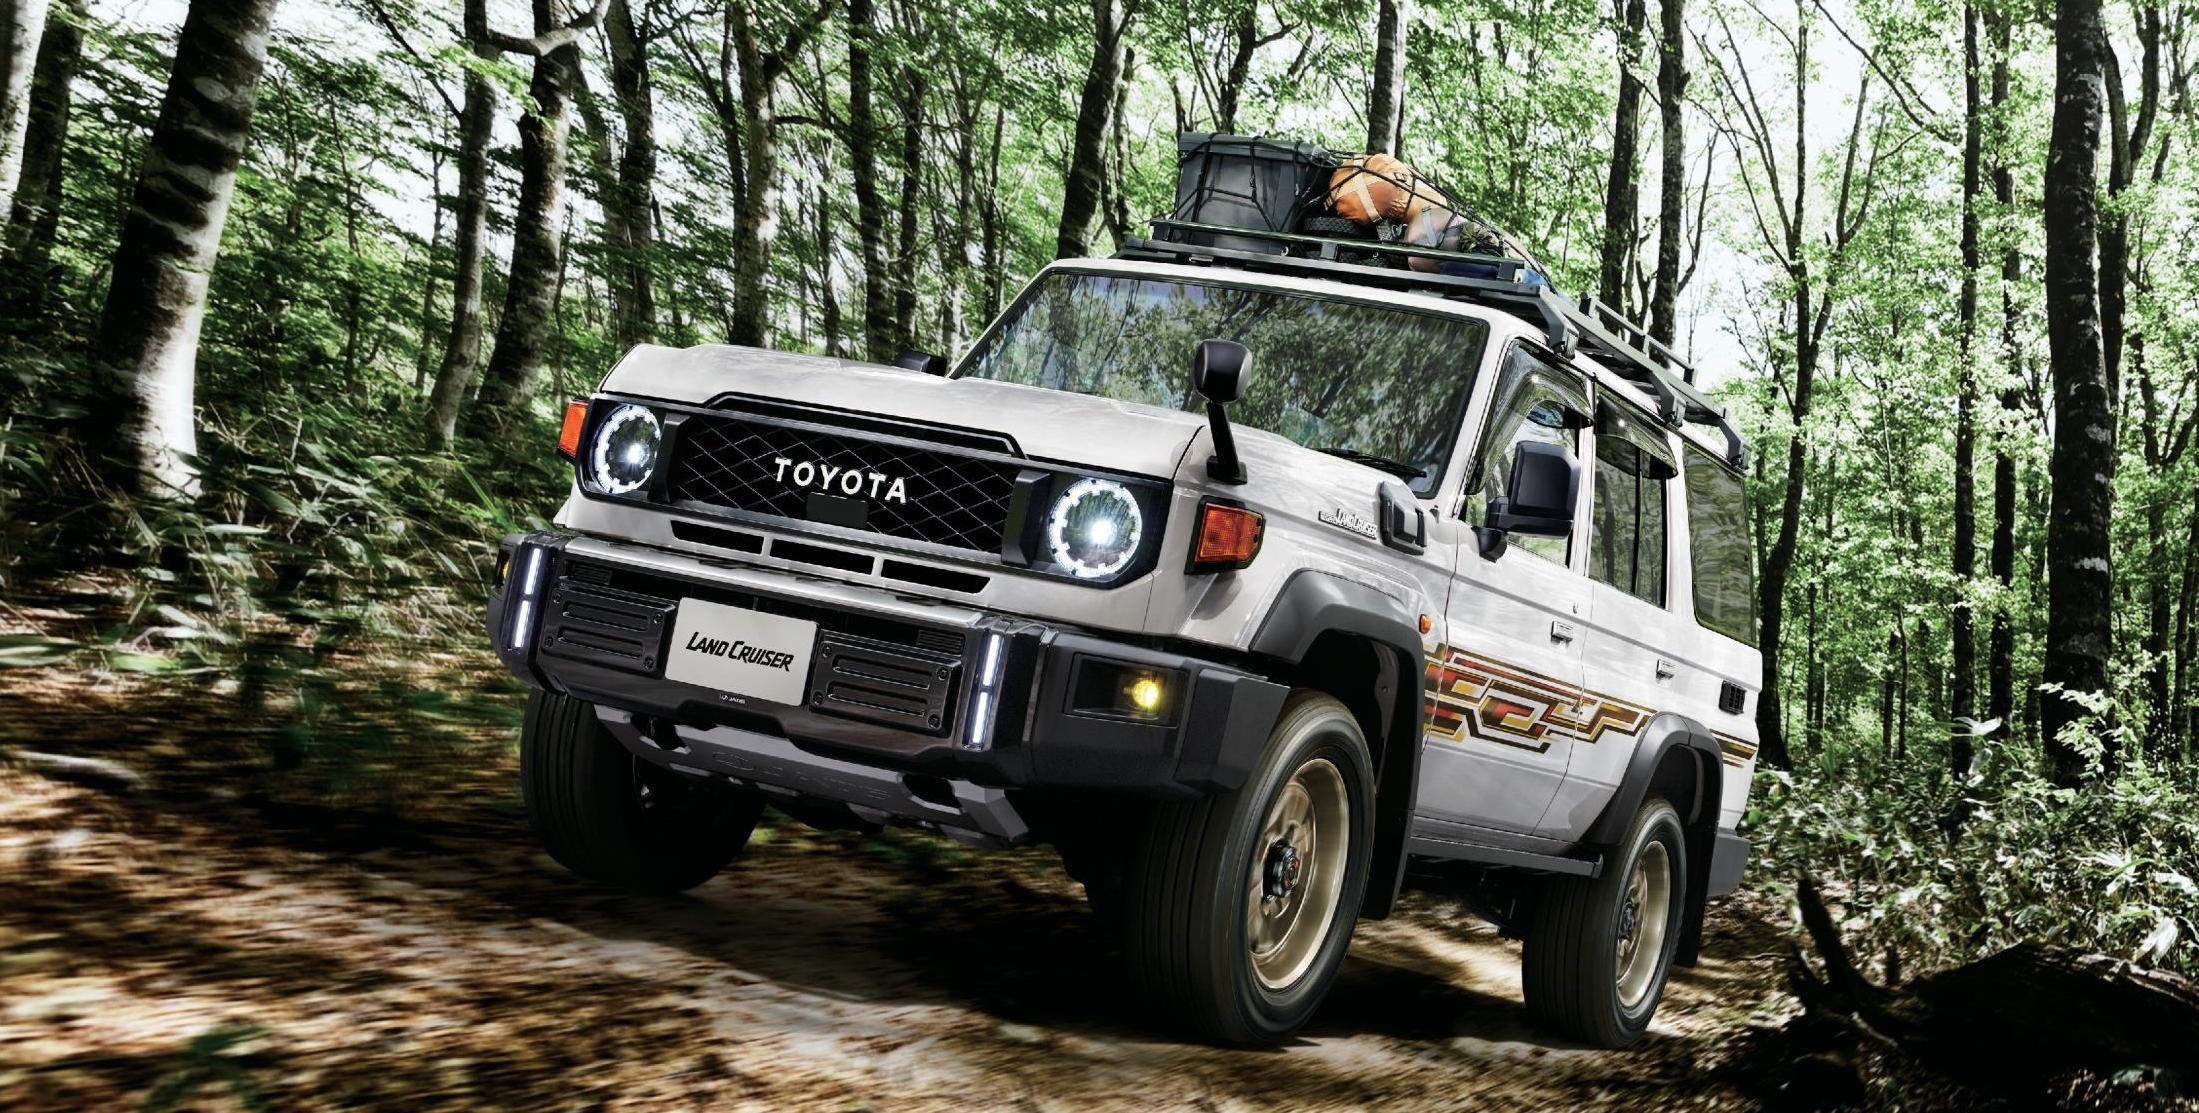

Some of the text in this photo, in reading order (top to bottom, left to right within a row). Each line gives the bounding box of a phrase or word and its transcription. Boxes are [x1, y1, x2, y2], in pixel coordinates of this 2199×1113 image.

[774, 457, 907, 505] TOYOTA
[685, 631, 795, 672] LAND CRUISER
